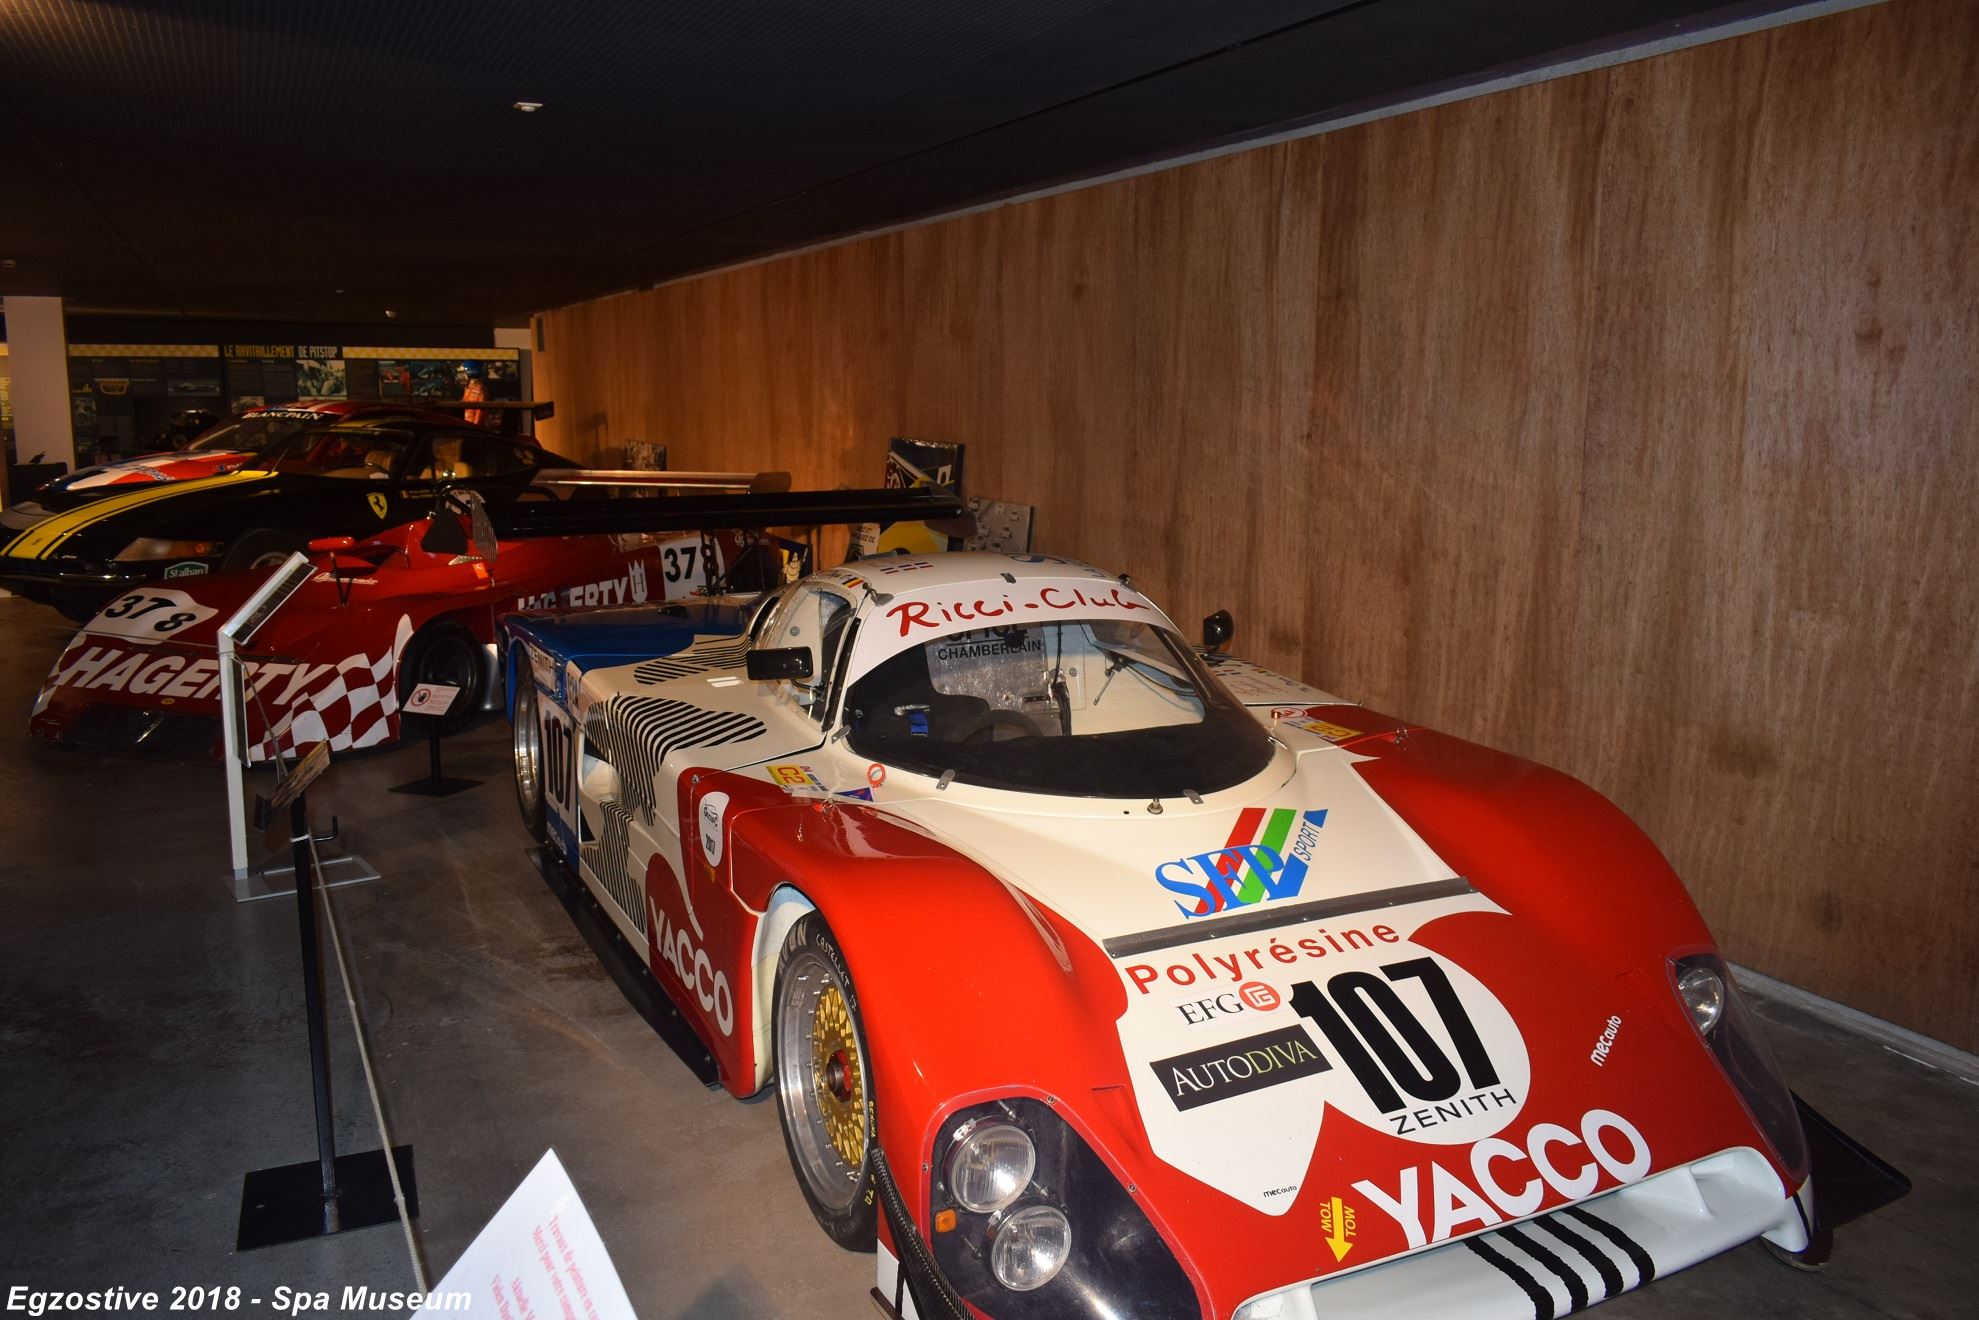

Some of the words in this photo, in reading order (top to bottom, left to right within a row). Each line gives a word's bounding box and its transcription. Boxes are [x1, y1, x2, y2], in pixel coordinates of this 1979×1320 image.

[223, 344, 234, 358] LE
[298, 345, 308, 358] DE
[1293, 820, 1321, 861] SPORT
[649, 894, 734, 1038] YACCO
[815, 933, 850, 987] CASTELLET
[1125, 923, 1400, 995] Polyrésine
[1175, 993, 1245, 1026] EFG
[1288, 956, 1501, 1114] 107
[1590, 1015, 1622, 1067] mecauto
[1170, 1039, 1318, 1097] AUTODIVA
[1388, 1088, 1518, 1136] ZENITH
[1263, 1185, 1298, 1198] mecauto
[1351, 1108, 1652, 1250] YACCO
[1319, 1202, 1333, 1233] TOW
[1343, 1205, 1357, 1237] TOW
